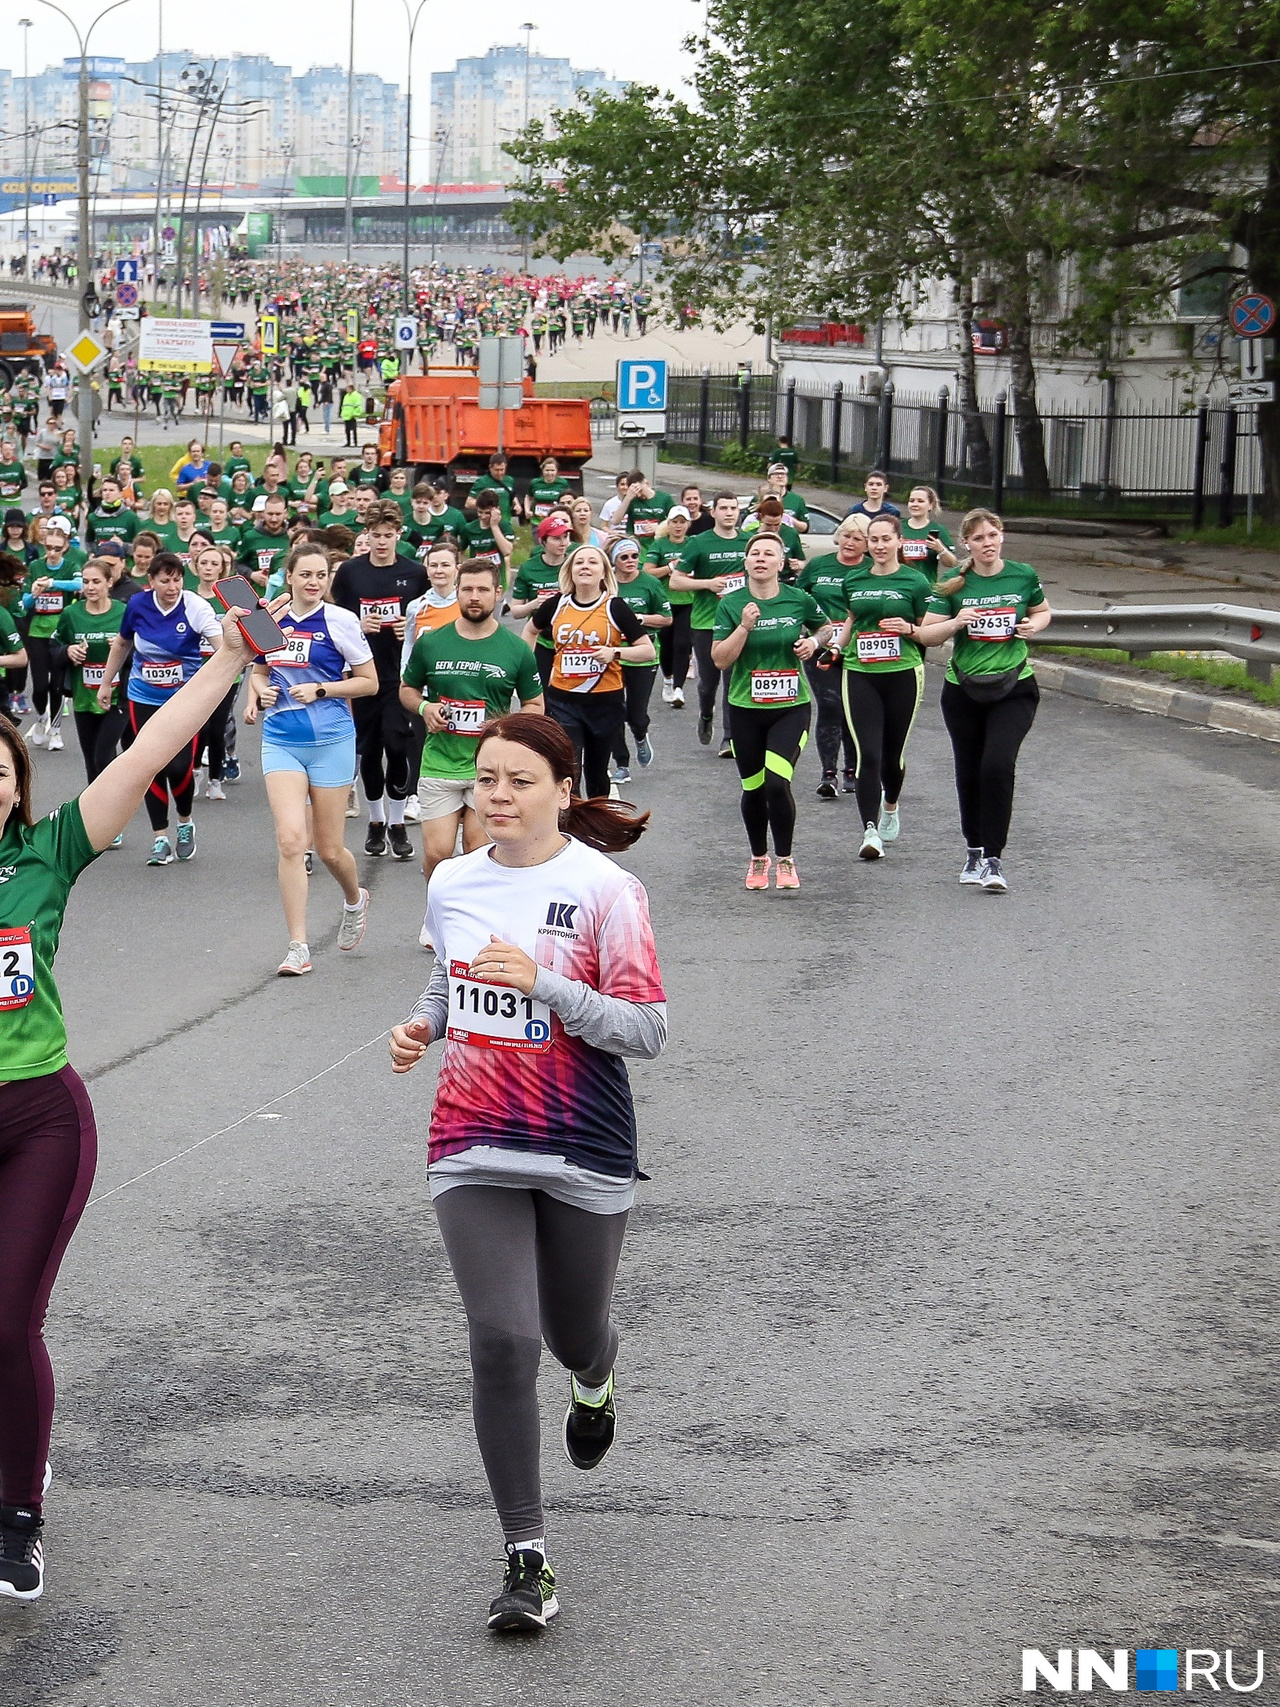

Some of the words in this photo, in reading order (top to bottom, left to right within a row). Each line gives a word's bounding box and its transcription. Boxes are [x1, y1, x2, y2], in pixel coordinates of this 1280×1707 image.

[629, 365, 657, 405] P
[557, 623, 600, 645] En+
[860, 639, 895, 651] 08905
[435, 660, 454, 670] БЕГИ,
[456, 660, 482, 671] ГЕРОЙ!
[145, 668, 179, 679] 10394
[755, 678, 793, 690] 08911
[455, 710, 478, 722] 171
[537, 928, 580, 940] КРИПТОНИТ
[15, 979, 29, 995] D
[456, 984, 533, 1020] 11031
[531, 1023, 544, 1040] D
